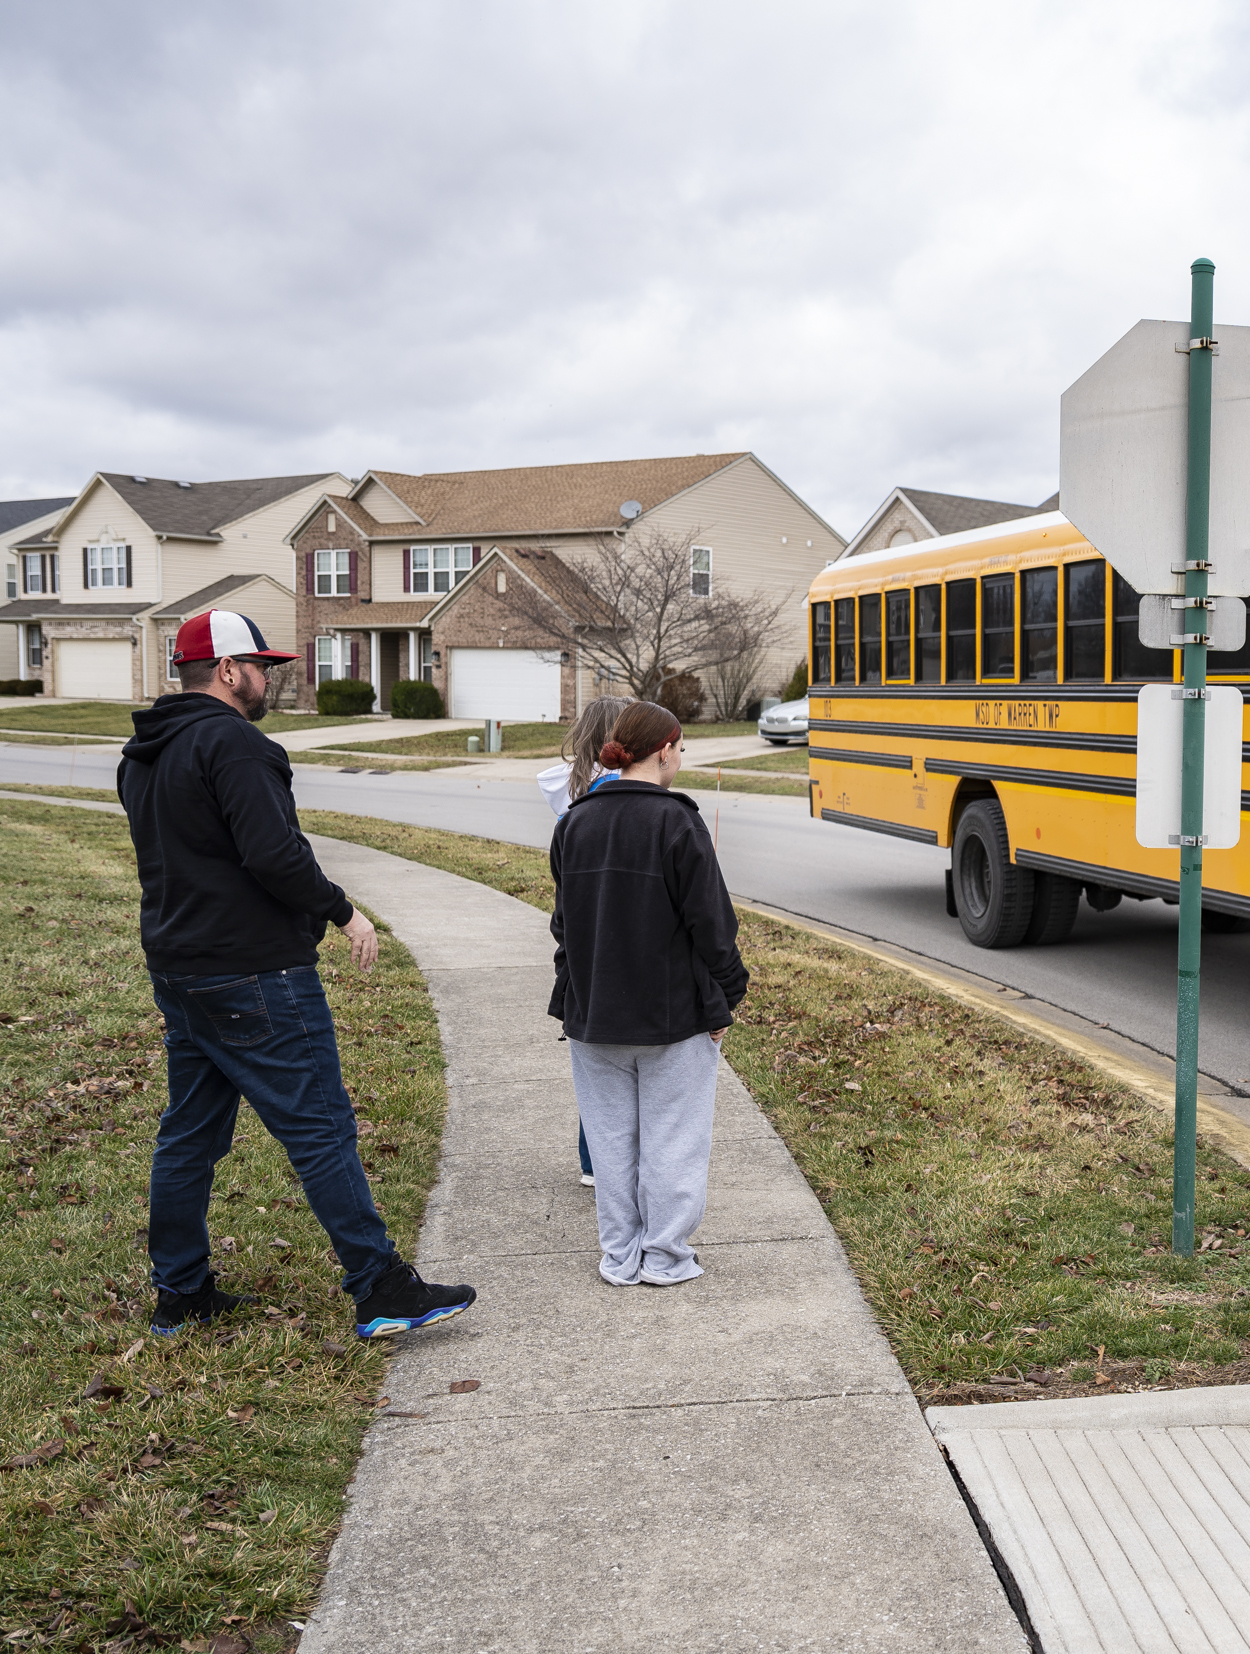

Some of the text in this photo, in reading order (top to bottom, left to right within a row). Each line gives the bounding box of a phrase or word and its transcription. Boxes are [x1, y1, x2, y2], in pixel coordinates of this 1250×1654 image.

[823, 699, 831, 718] 103
[975, 702, 1060, 729] MSD OF WARREN TWP
